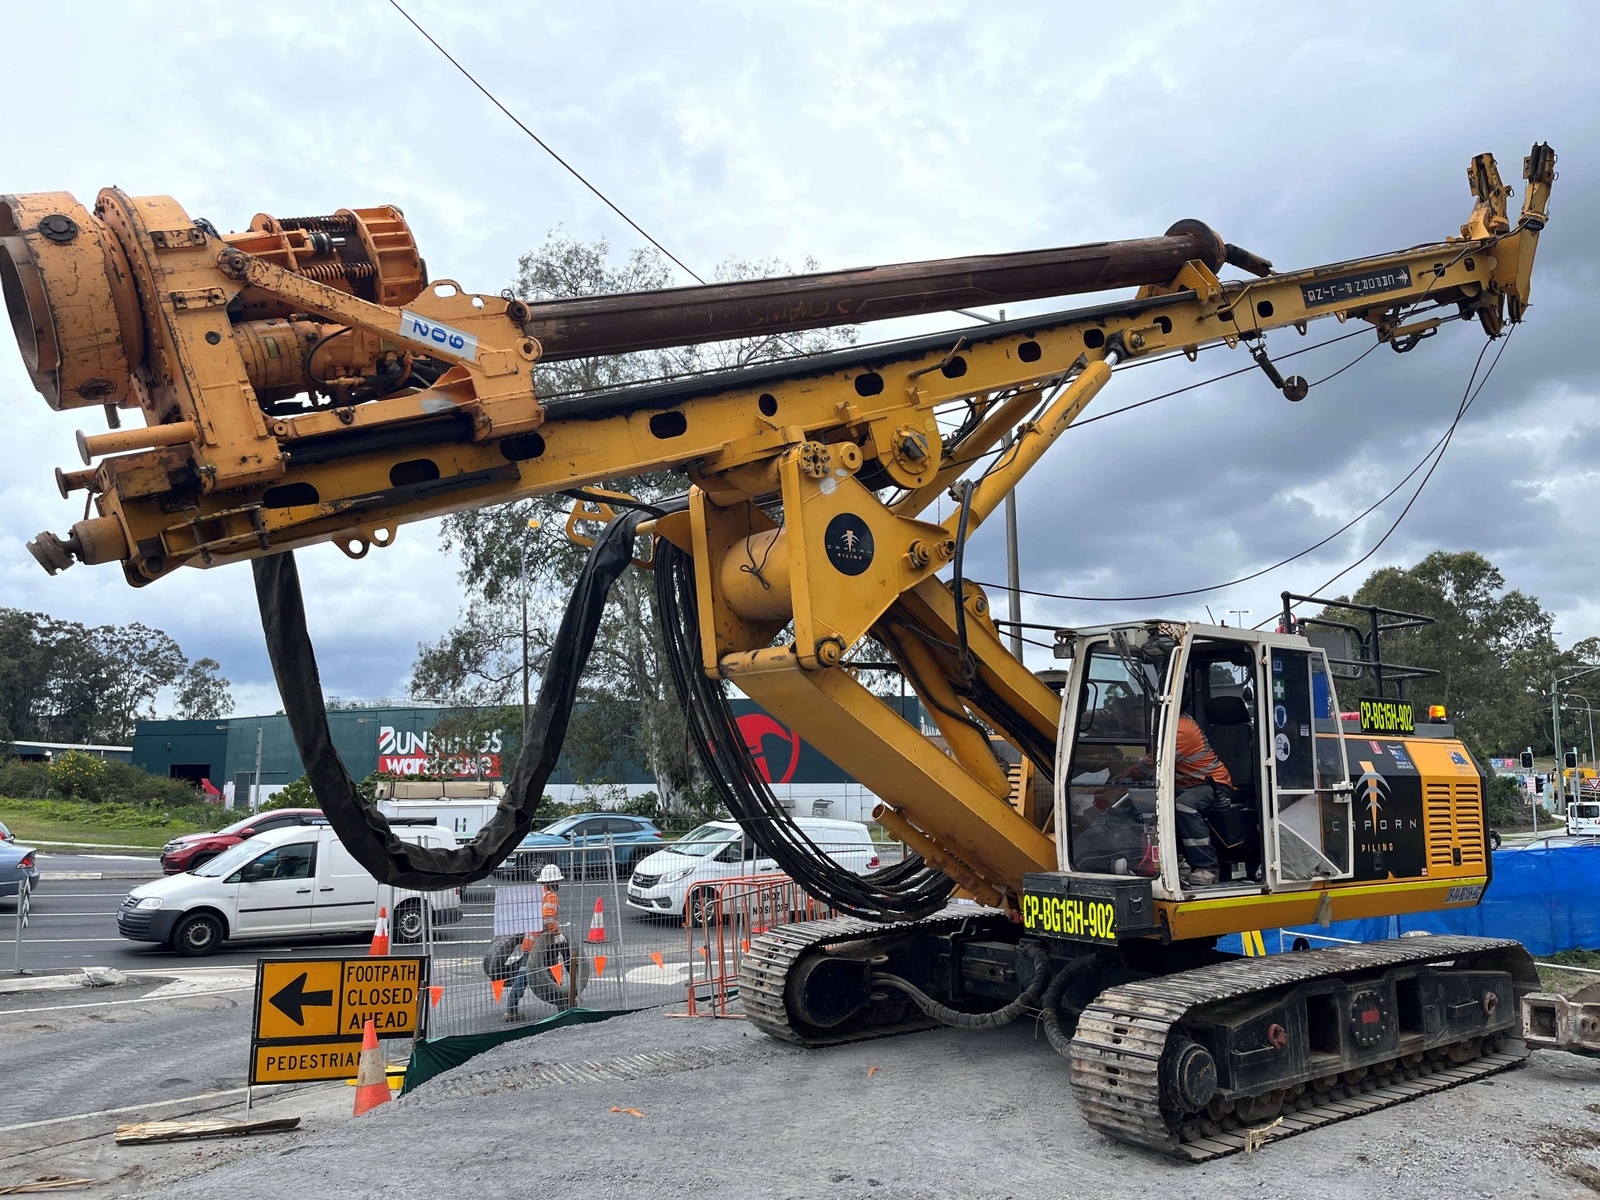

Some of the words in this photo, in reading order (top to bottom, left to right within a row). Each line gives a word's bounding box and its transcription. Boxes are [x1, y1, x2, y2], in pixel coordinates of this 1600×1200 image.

[1360, 701, 1414, 731] CP-BG15H-902
[1361, 843, 1394, 852] PILING
[1023, 894, 1117, 939] CP-BG15H-902
[347, 965, 417, 983] FOOTPATH
[347, 988, 413, 1007] CLOSED
